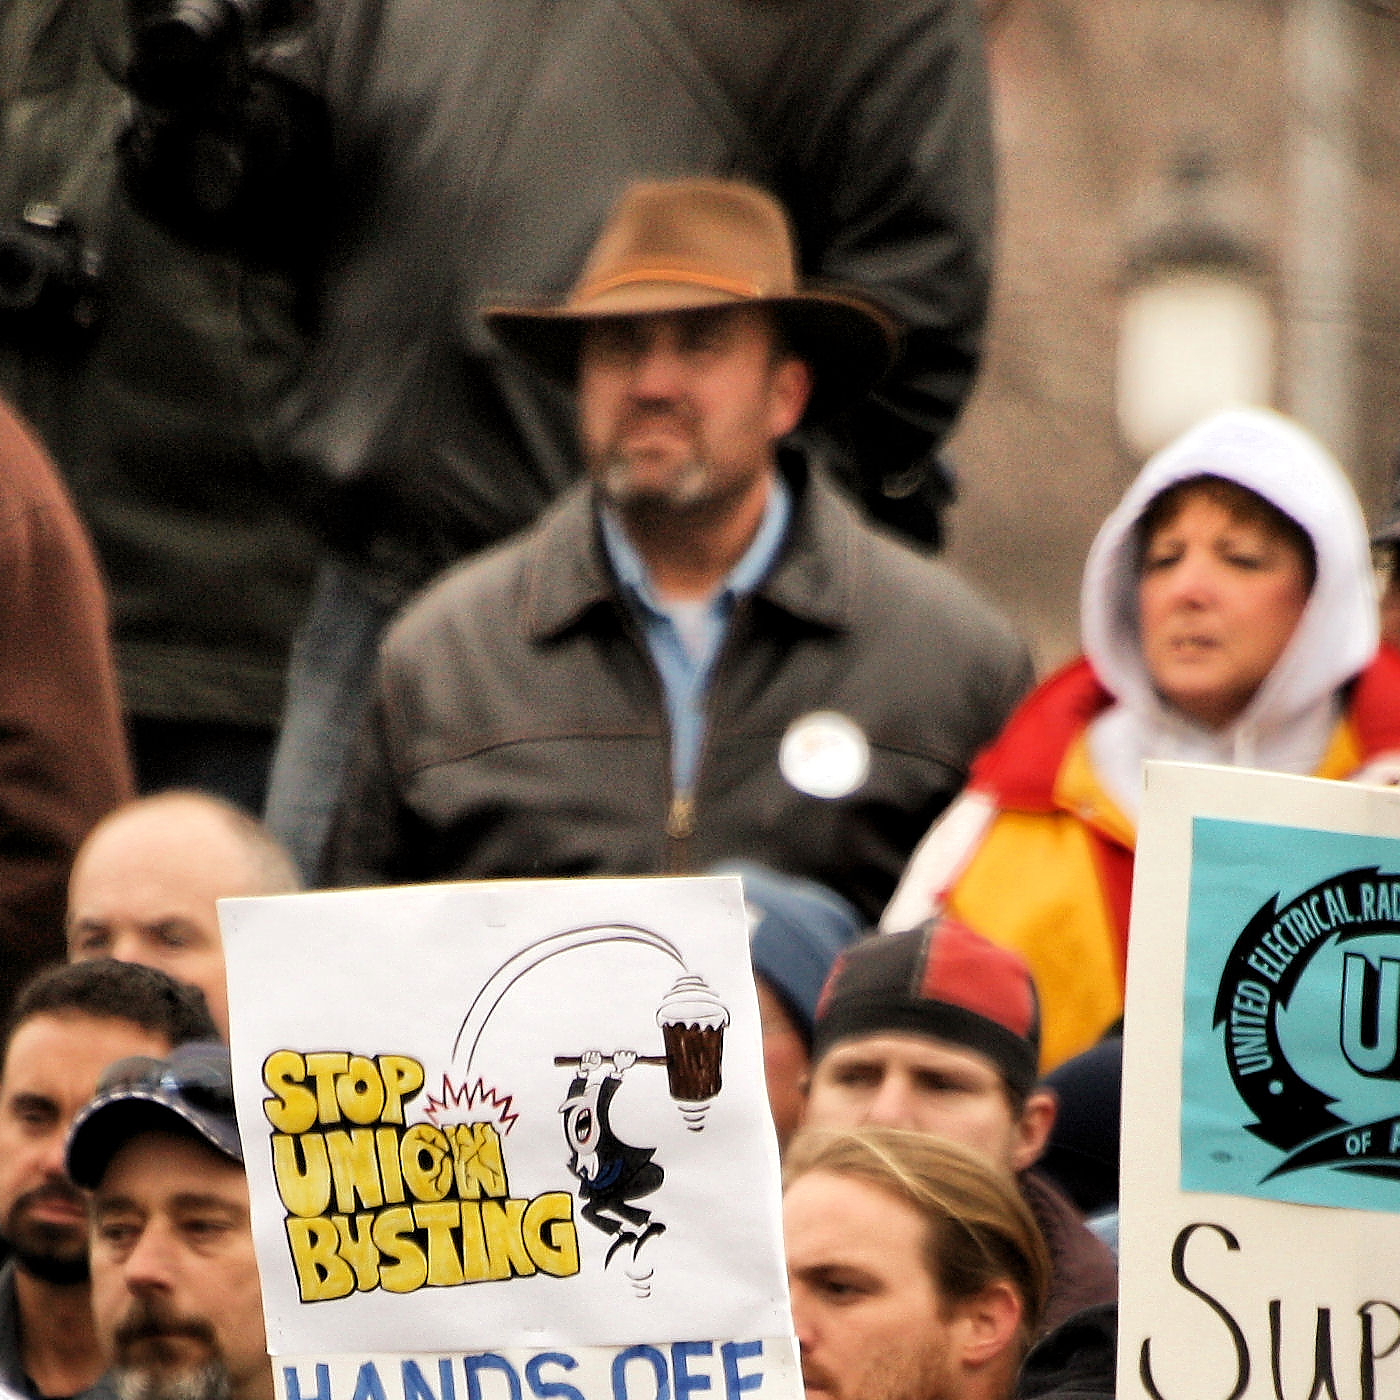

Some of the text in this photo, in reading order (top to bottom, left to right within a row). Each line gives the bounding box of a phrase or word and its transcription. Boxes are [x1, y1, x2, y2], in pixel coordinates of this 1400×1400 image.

[1231, 980, 1274, 1077] UNITED
[262, 1048, 426, 1136] STOP
[271, 1122, 511, 1211] UNION
[1345, 1131, 1372, 1156] OF
[282, 1191, 581, 1303] BUSTING
